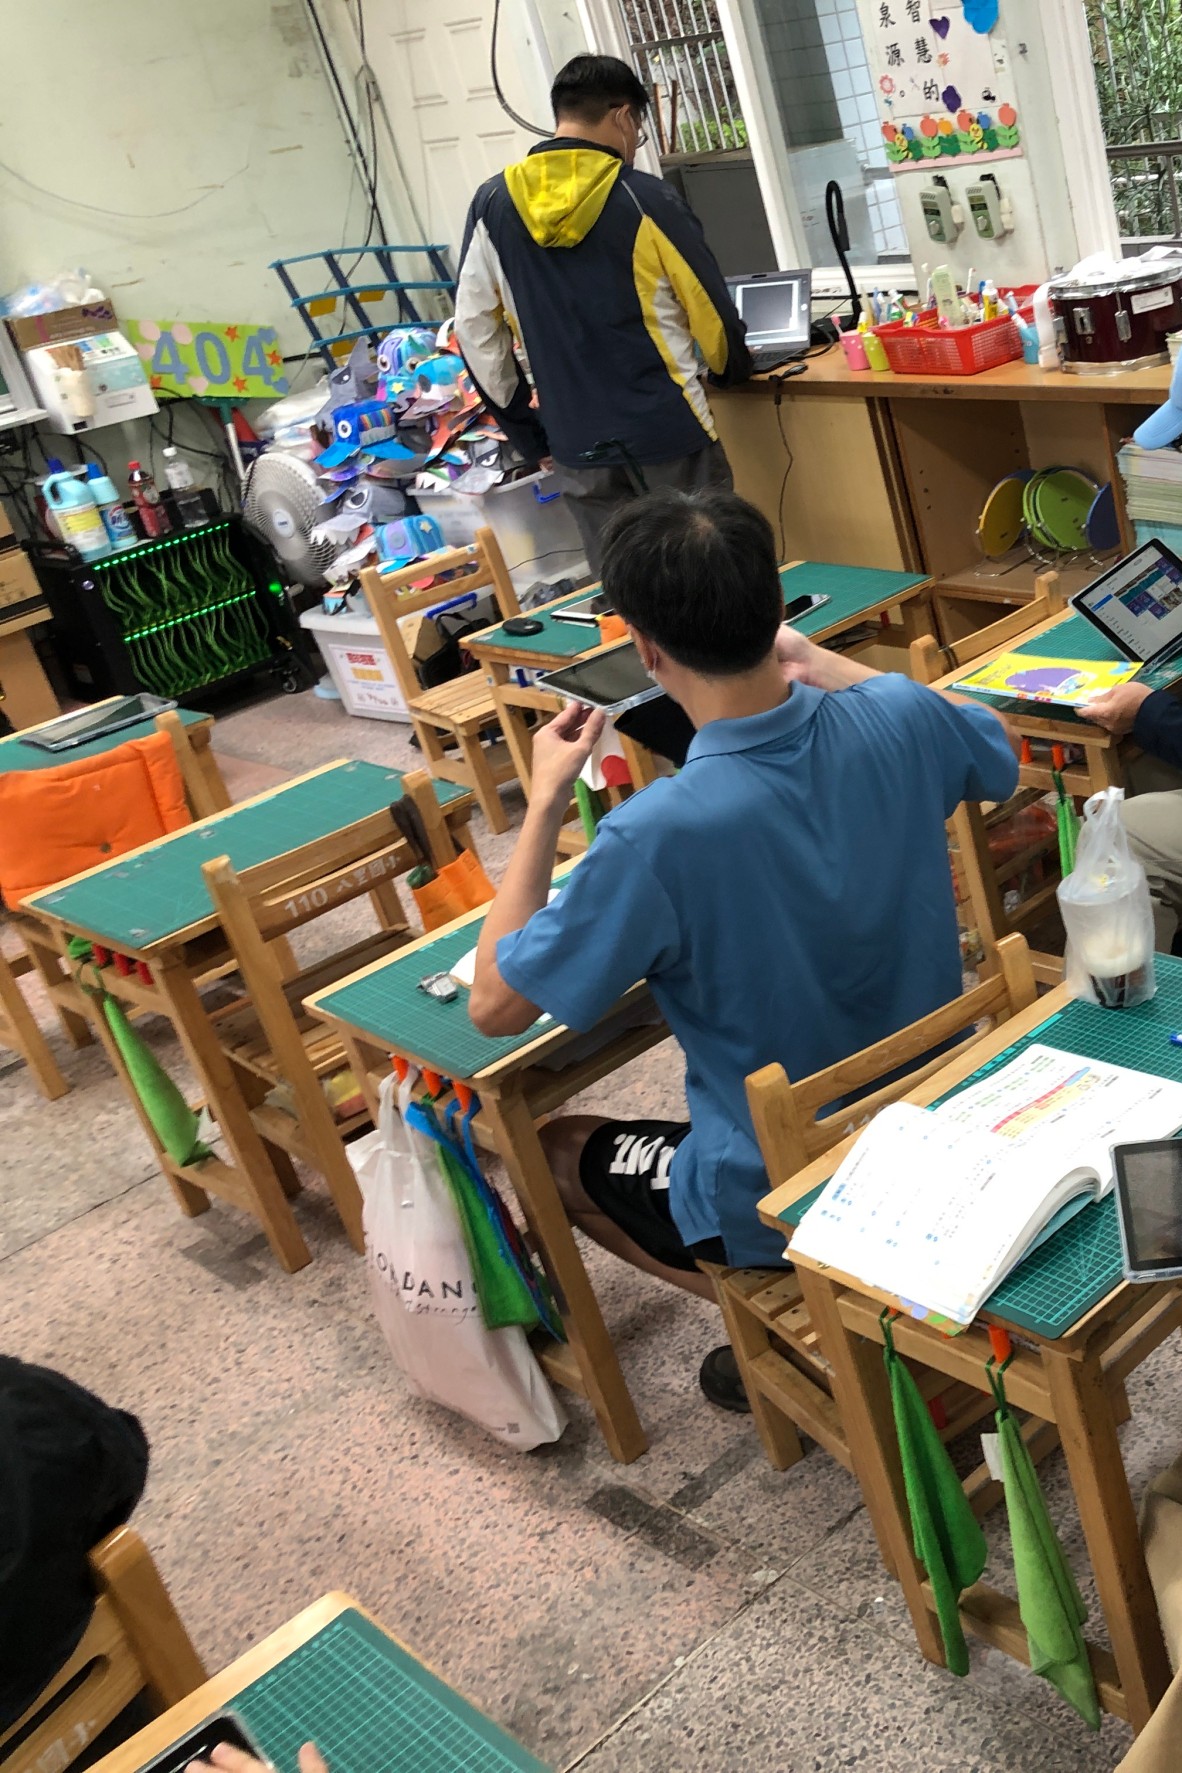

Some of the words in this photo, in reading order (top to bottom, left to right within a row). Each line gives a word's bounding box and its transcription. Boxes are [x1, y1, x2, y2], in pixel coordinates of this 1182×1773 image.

[151, 330, 277, 387] 404
[284, 887, 329, 919] 110
[335, 854, 402, 897] 八里國小
